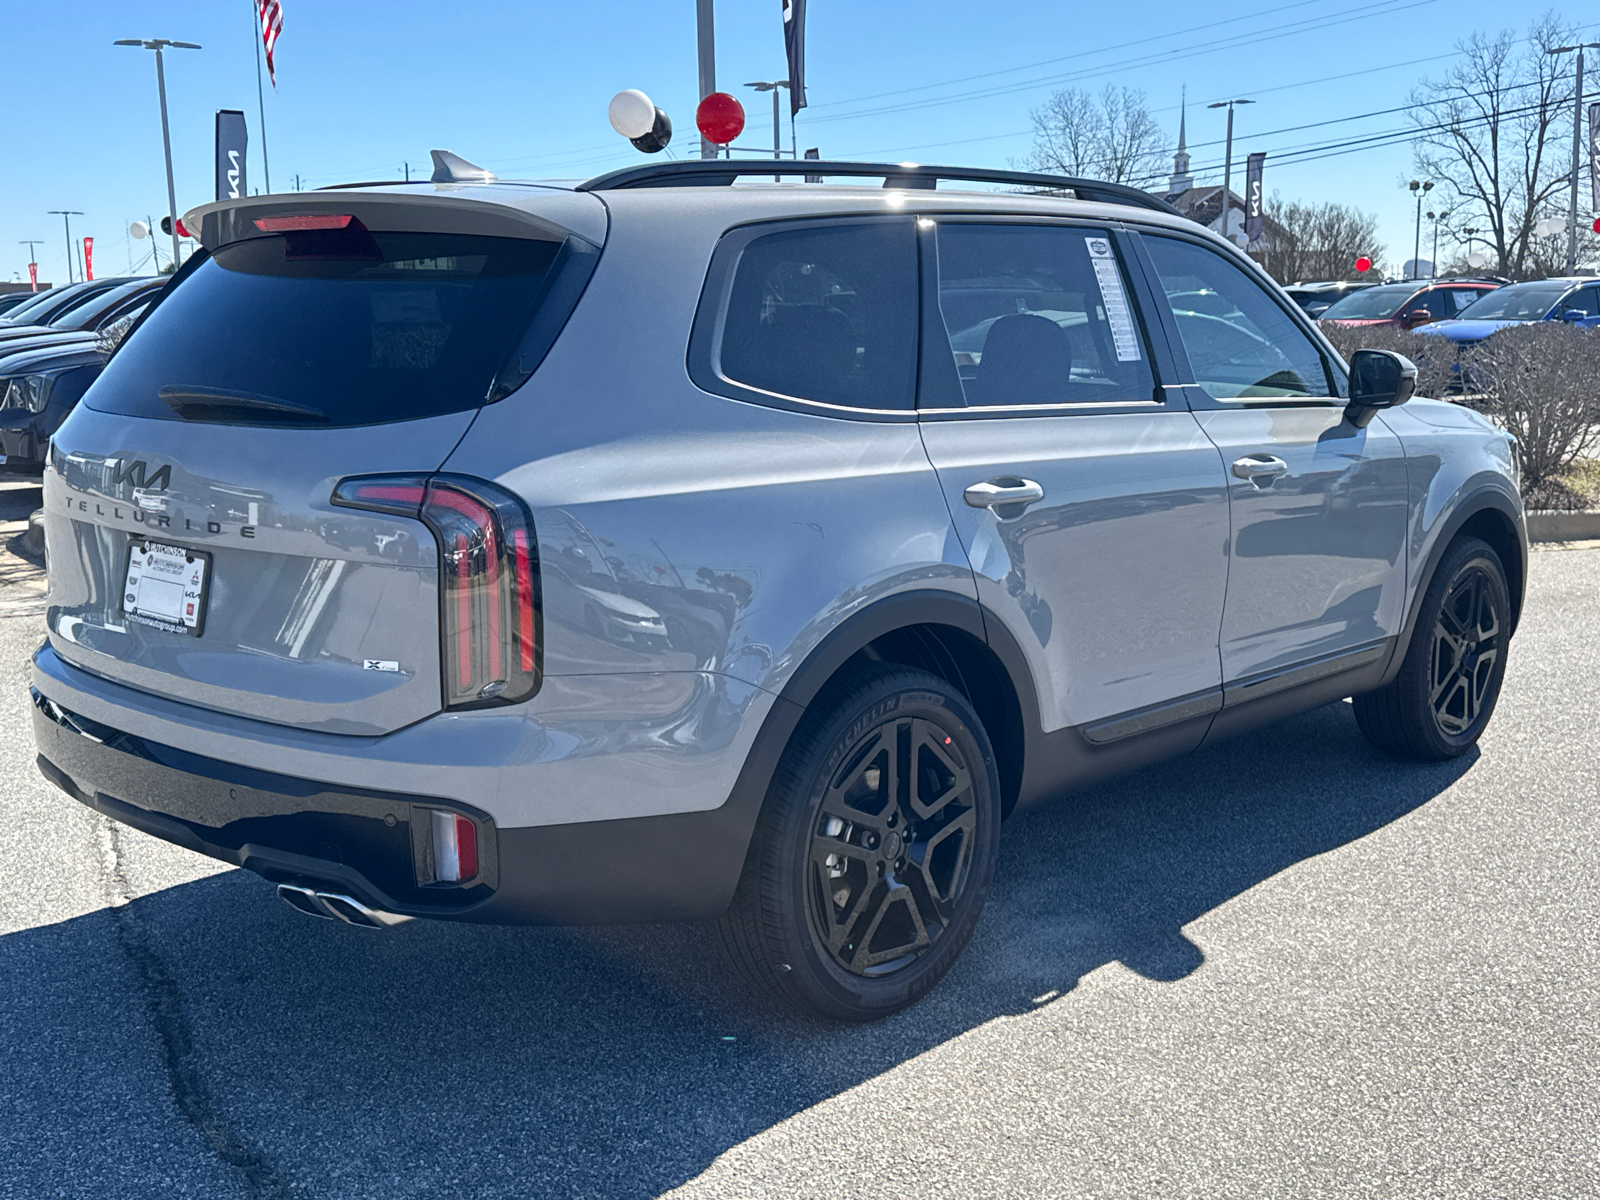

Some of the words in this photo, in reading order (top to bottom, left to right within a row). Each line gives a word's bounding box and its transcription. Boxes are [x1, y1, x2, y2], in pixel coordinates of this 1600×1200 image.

[112, 458, 171, 491] KIA
[65, 496, 256, 539] TELLURIDE
[151, 543, 187, 557] HUTCHINSON
[828, 698, 897, 769] MICHELIN
